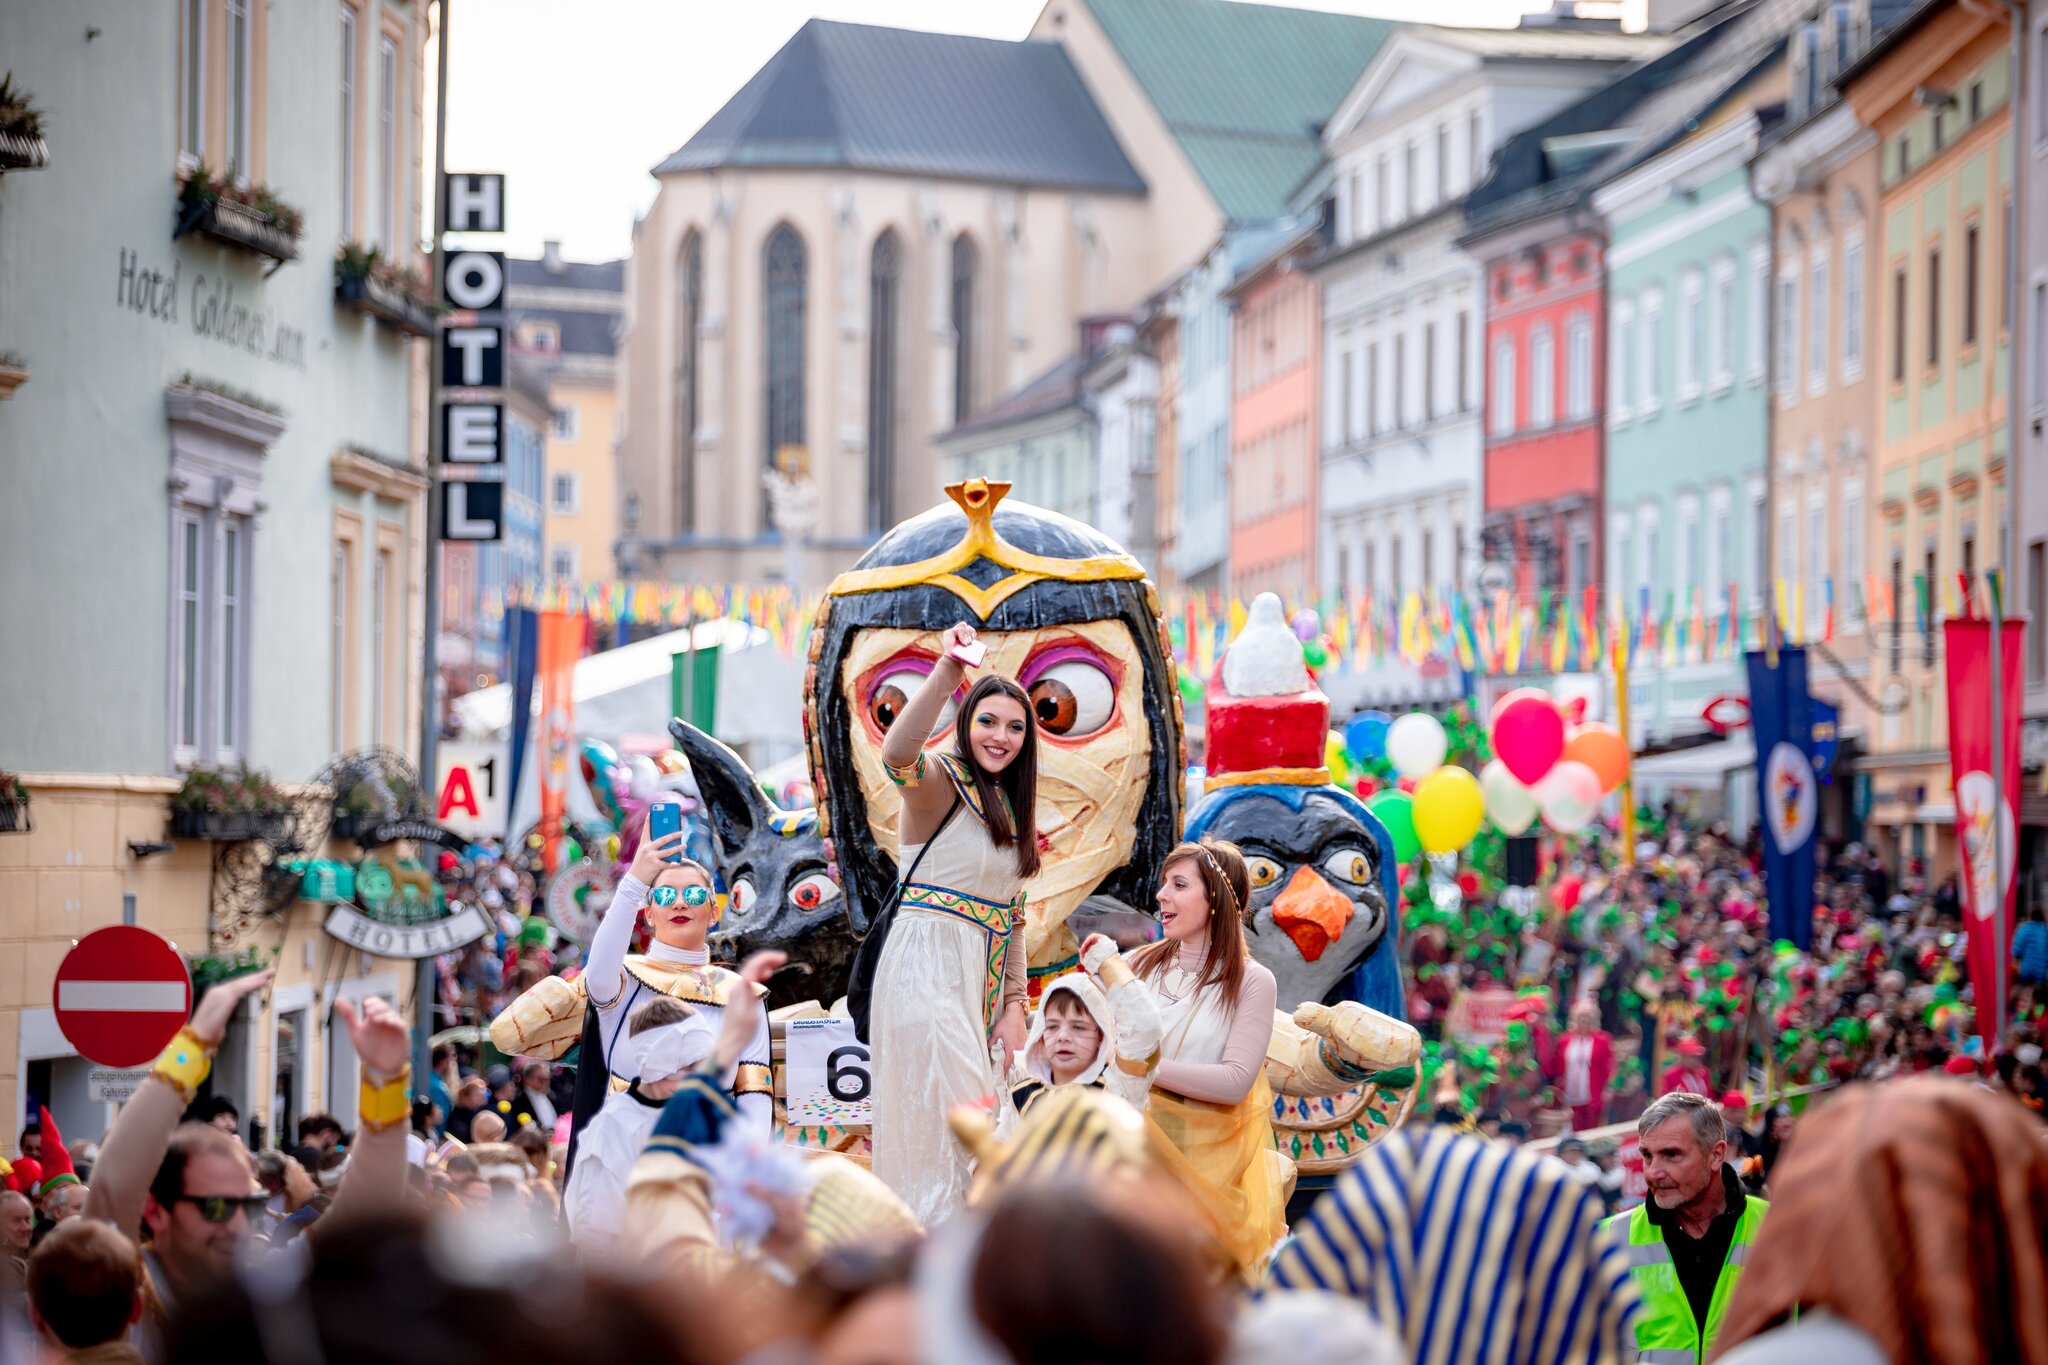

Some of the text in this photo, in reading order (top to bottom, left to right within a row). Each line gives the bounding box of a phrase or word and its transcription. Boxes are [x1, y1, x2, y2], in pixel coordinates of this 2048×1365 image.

[117, 246, 181, 323] Hotel
[445, 174, 503, 540] HOTEL
[438, 757, 495, 819] A1
[350, 921, 462, 950] HOTEL
[827, 1046, 871, 1102] 6
